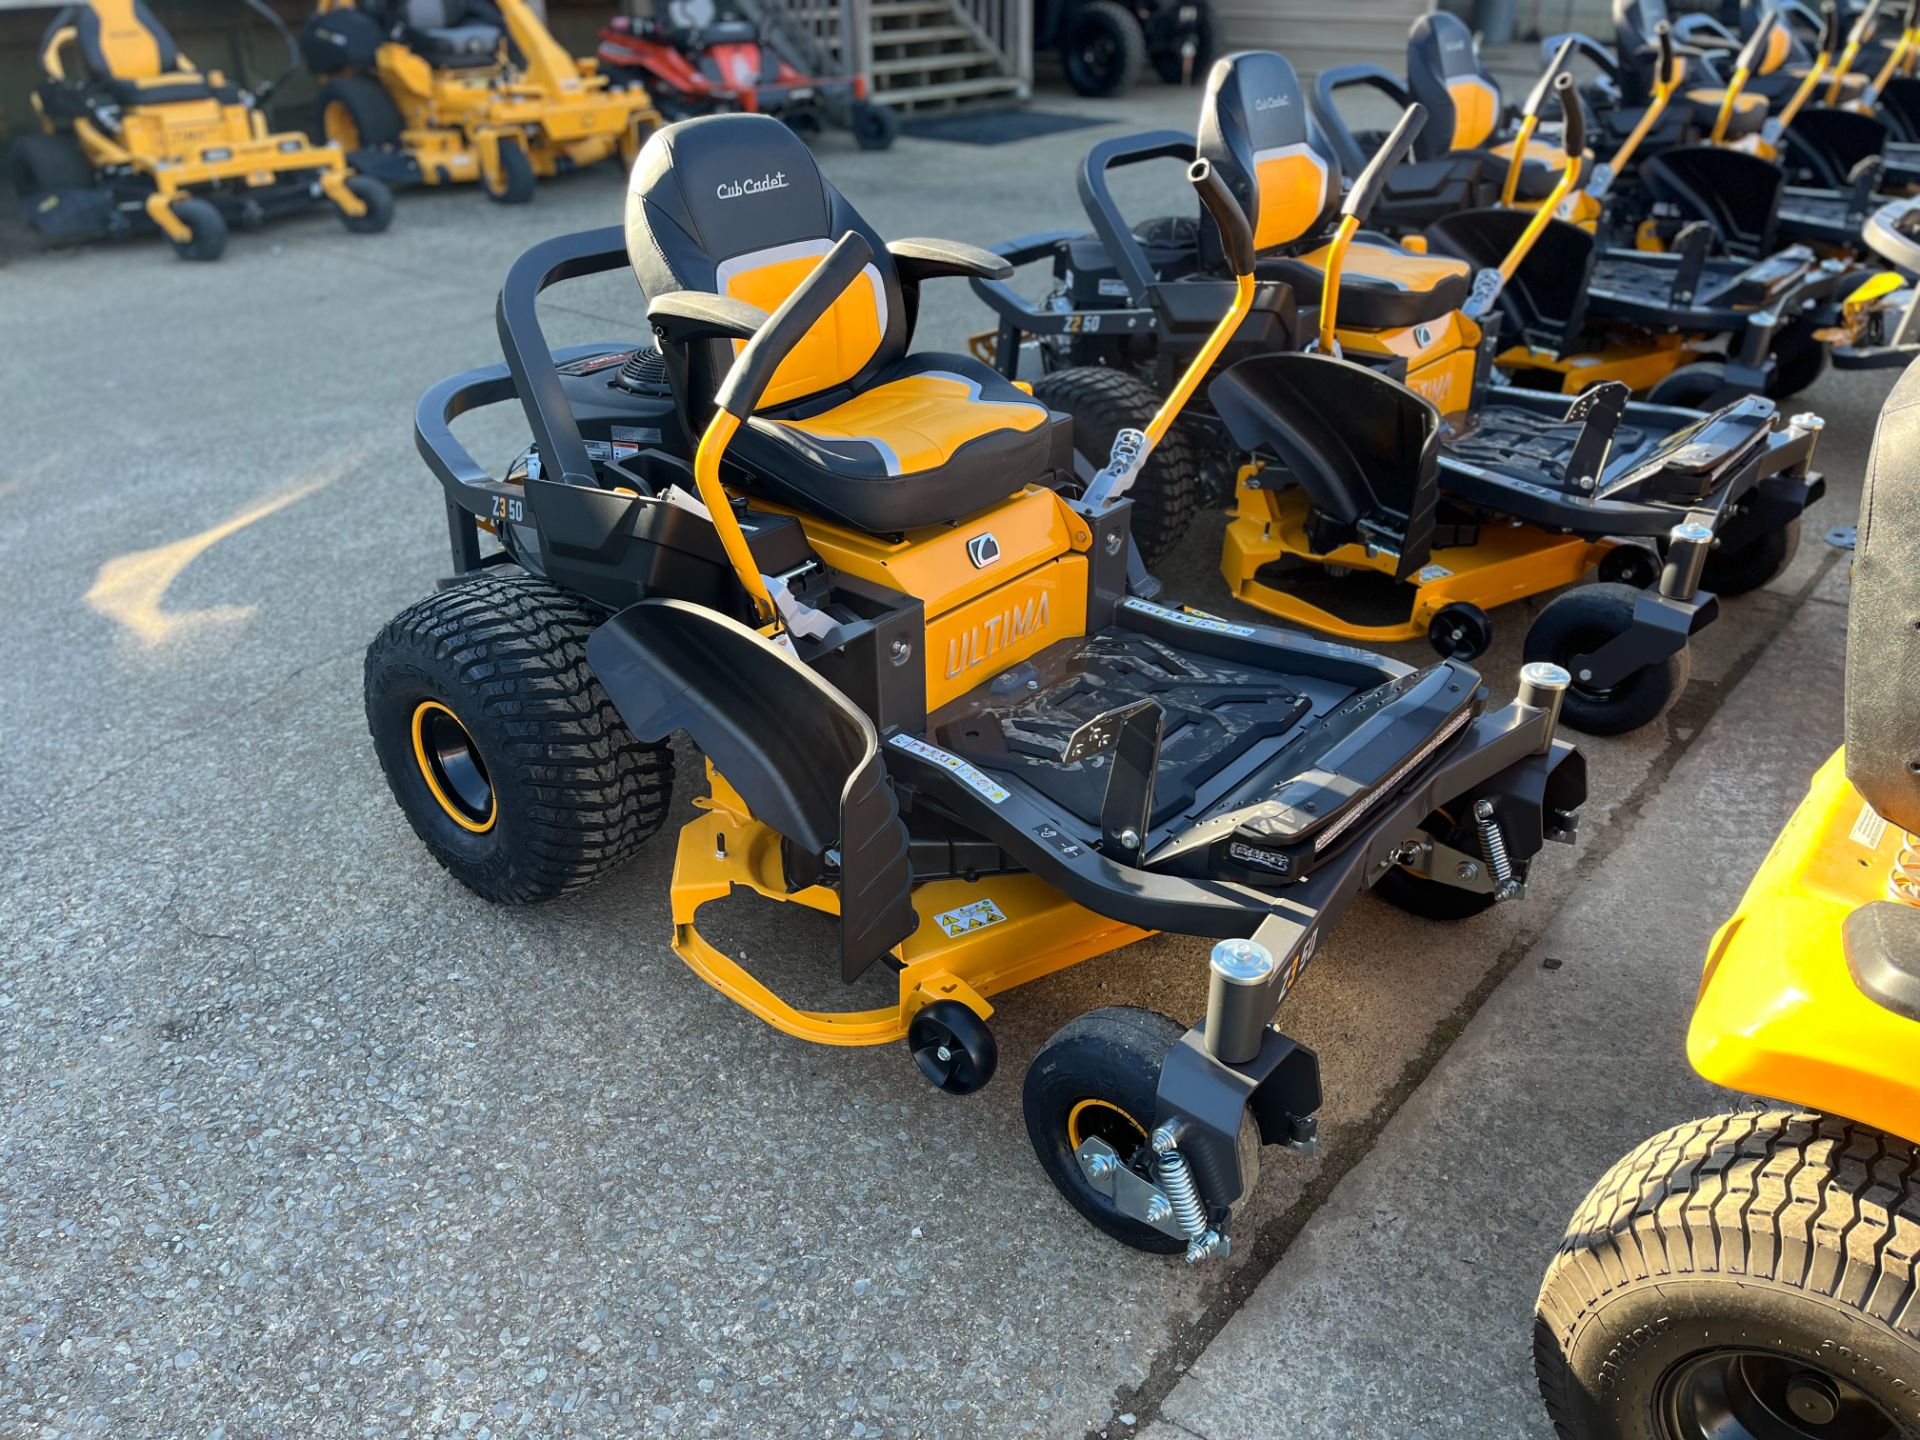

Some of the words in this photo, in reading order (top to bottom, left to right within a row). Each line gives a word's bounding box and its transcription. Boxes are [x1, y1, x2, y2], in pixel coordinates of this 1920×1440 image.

[716, 180, 743, 200] Cub
[743, 171, 789, 194] Cadet
[945, 590, 1049, 680] ULTIMA
